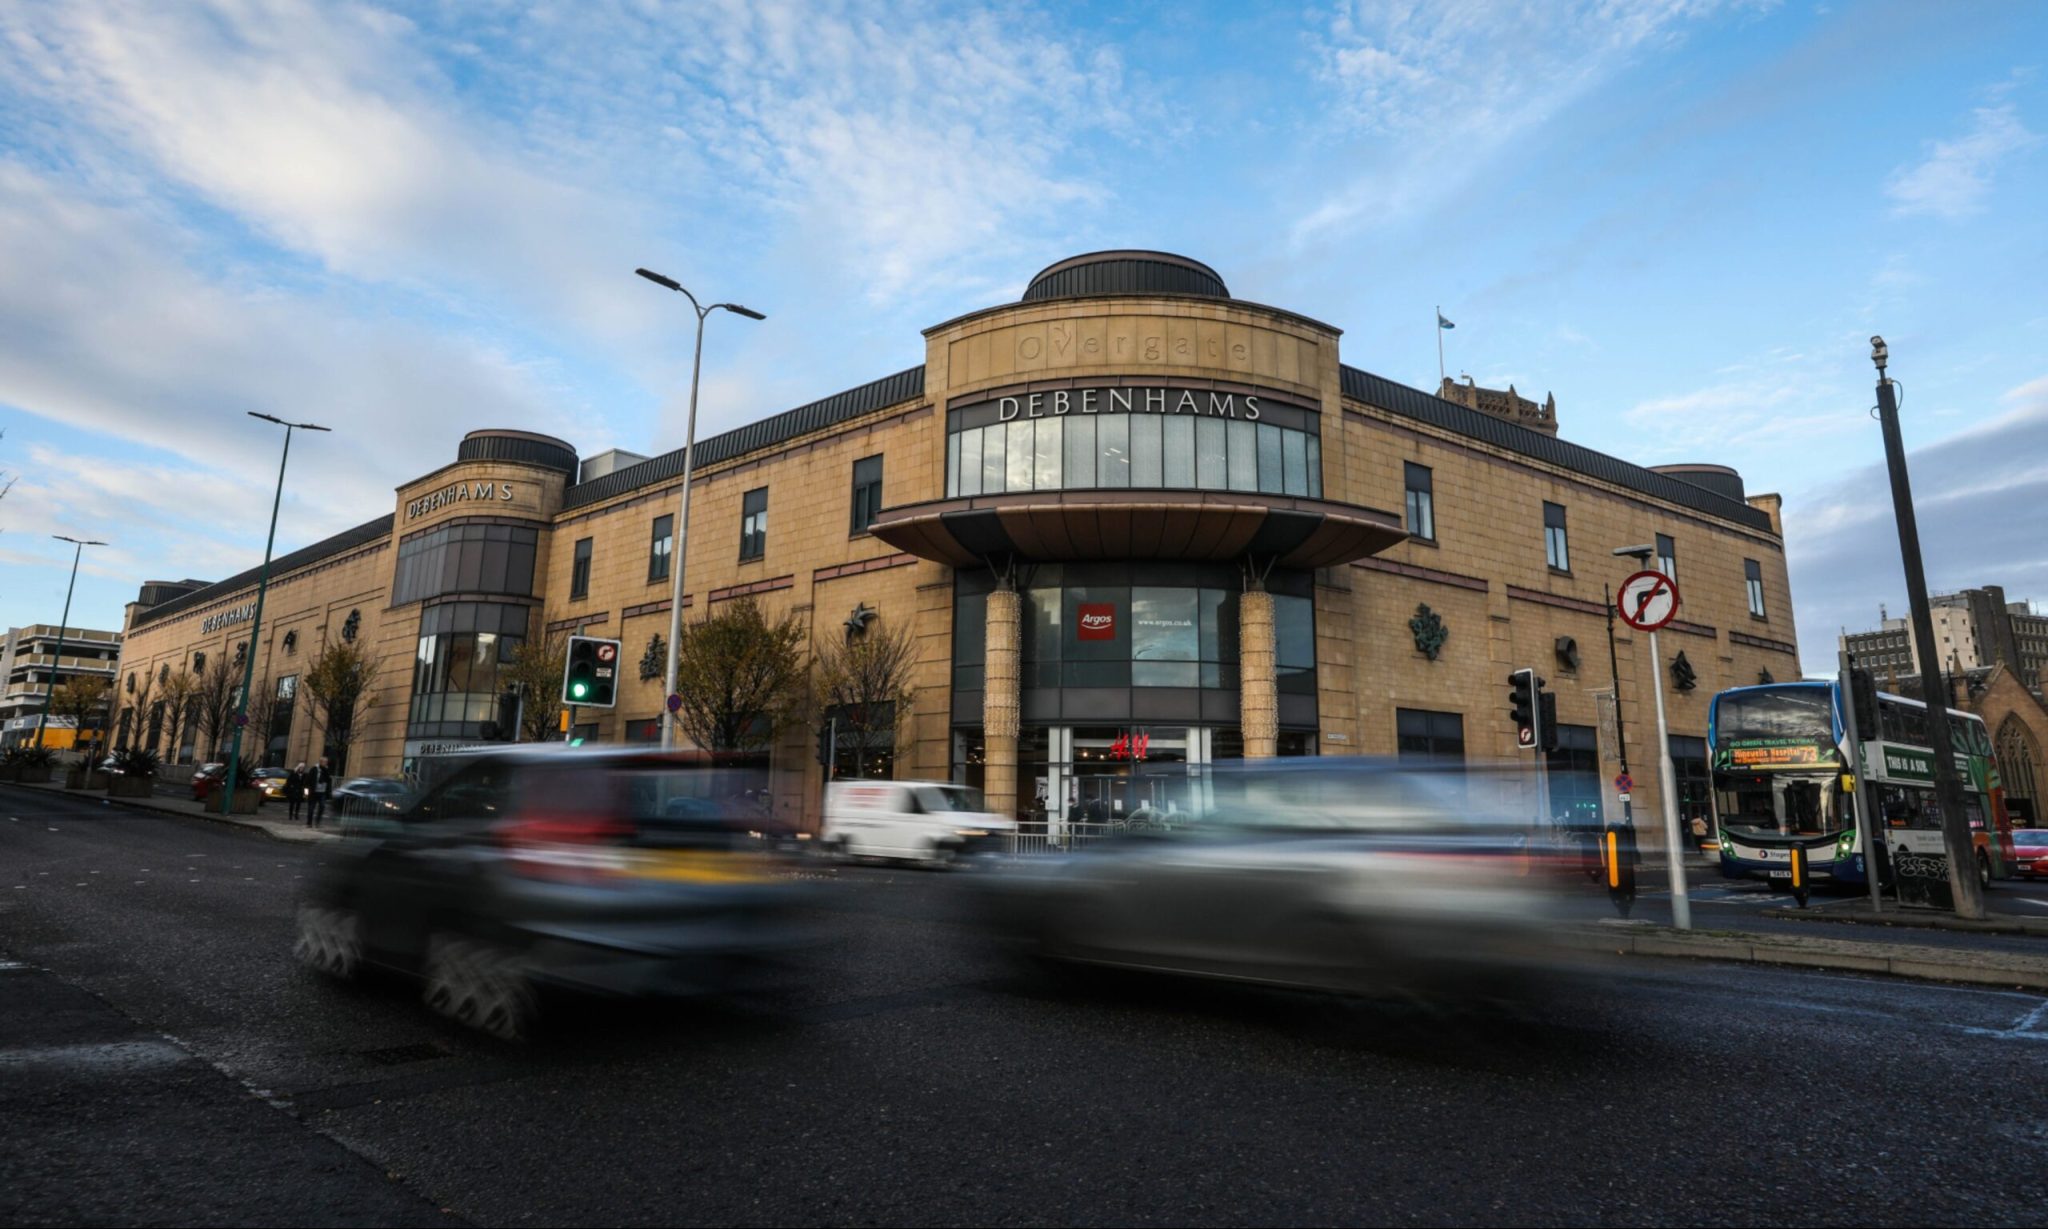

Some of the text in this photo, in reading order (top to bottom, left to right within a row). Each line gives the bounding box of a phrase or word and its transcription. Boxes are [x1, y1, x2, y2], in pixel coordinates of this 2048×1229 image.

[999, 387, 1261, 422] DEBENHAMS
[409, 482, 513, 519] DEBENHAMS
[201, 602, 257, 635] DEBENHAMS
[1082, 613, 1113, 626] Argos
[1138, 619, 1193, 628] www.argos.co.uk
[1802, 747, 1817, 762] 73
